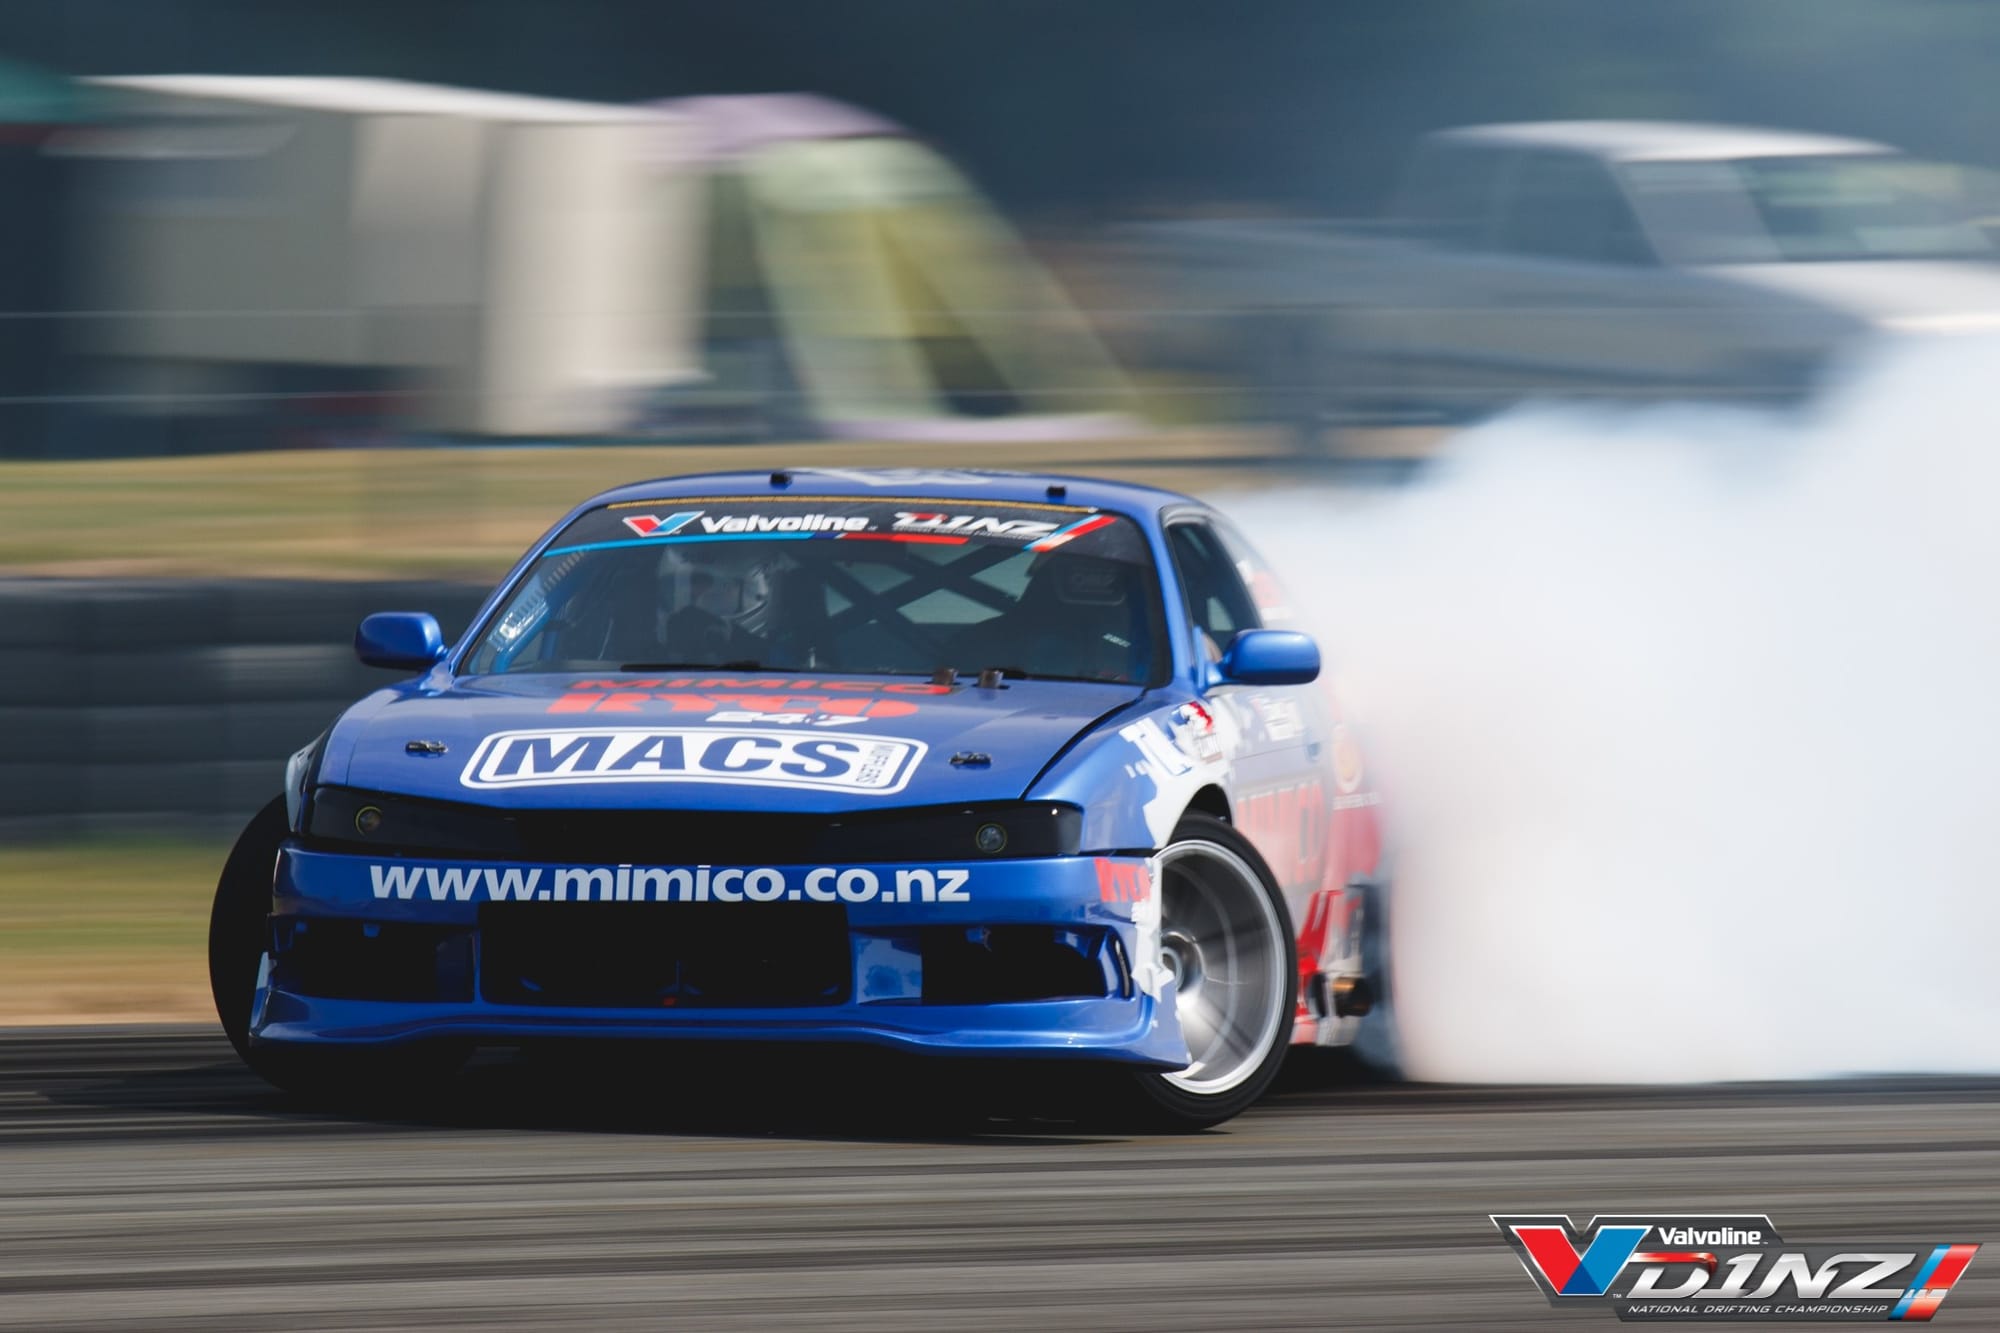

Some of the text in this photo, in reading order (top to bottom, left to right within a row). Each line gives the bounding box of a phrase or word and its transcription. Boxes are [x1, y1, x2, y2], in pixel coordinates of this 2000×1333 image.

[700, 513, 870, 534] Valvoline
[569, 679, 952, 695] MIMICO
[545, 693, 919, 718] RYCO
[494, 735, 858, 778] MACS
[369, 864, 971, 903] www.mimico.co.nz
